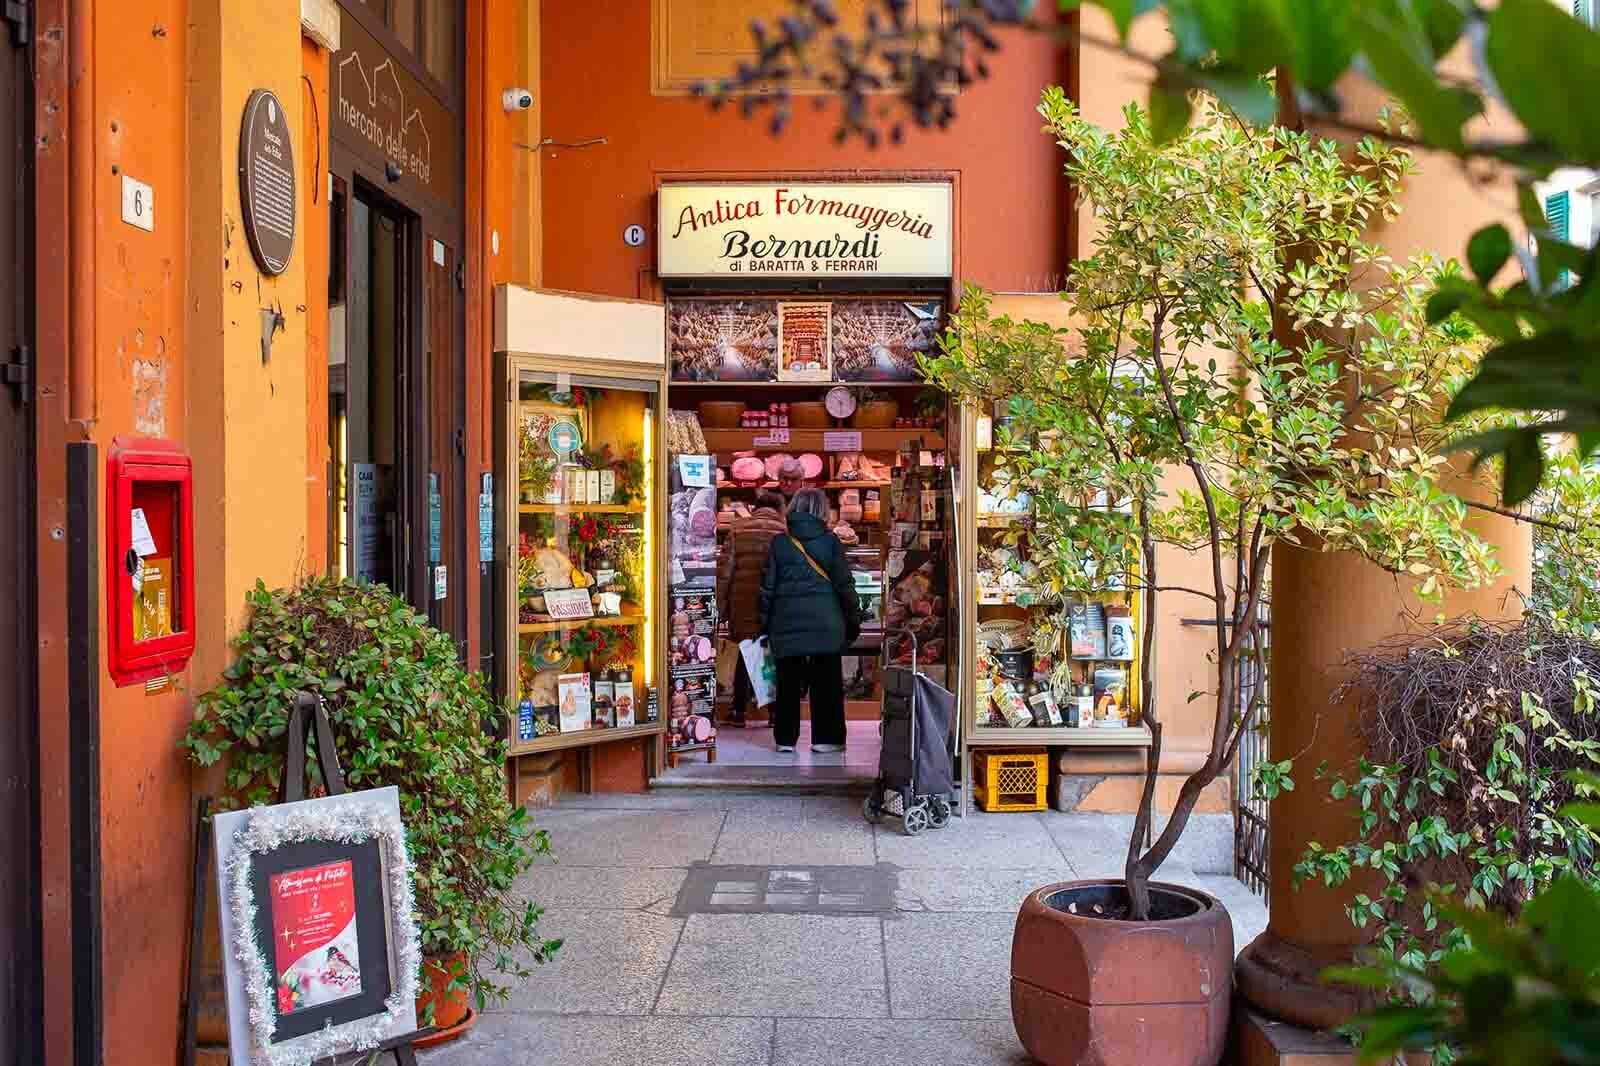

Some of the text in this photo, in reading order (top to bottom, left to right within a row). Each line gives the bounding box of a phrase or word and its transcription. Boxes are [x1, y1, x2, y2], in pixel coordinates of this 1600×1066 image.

[338, 97, 431, 184] mercato delle erbe
[135, 190, 143, 217] 6
[672, 188, 934, 239] Antica Formaggeria
[631, 228, 639, 243] C
[718, 229, 883, 259] Bernardi
[729, 259, 878, 271] di BARATTA & FERRARI
[550, 600, 593, 617] PASSIONE
